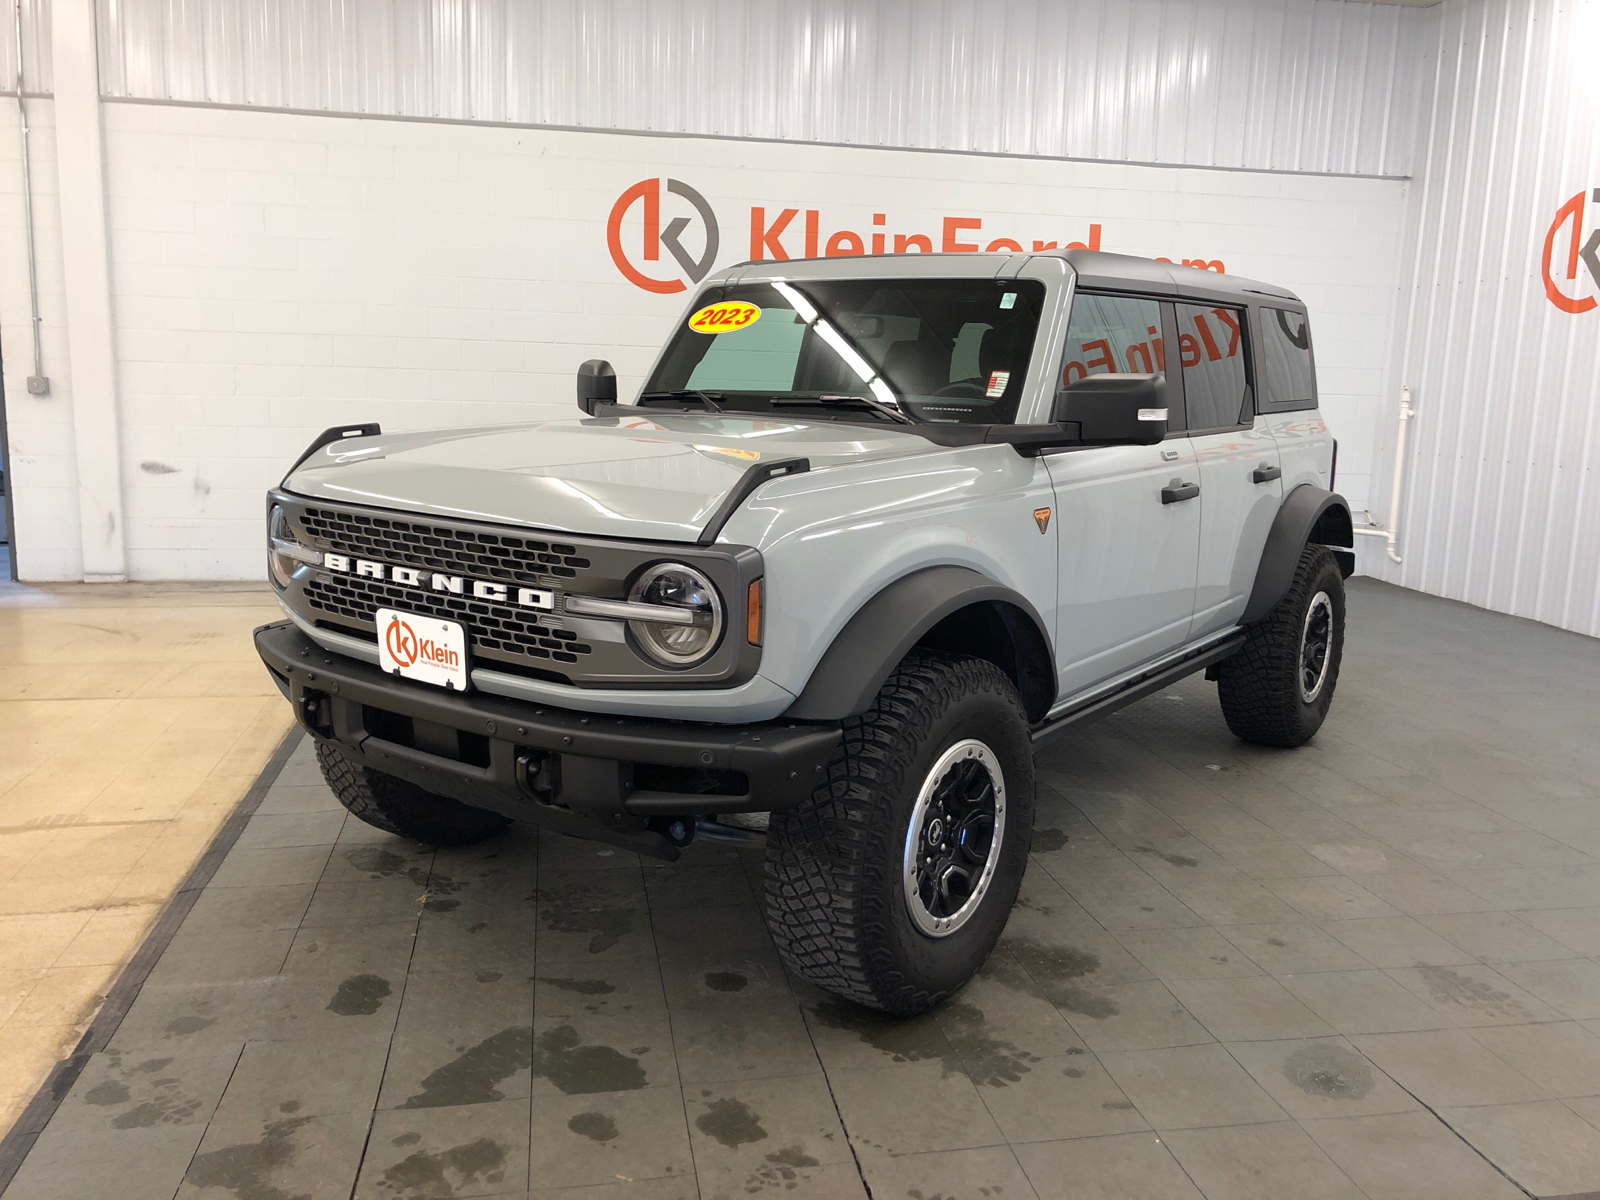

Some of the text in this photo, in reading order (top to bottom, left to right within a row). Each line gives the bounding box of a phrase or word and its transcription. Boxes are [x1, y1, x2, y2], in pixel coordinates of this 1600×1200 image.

[693, 308, 756, 326] 2023
[324, 553, 555, 610] BRONCO
[419, 638, 459, 667] Klein
